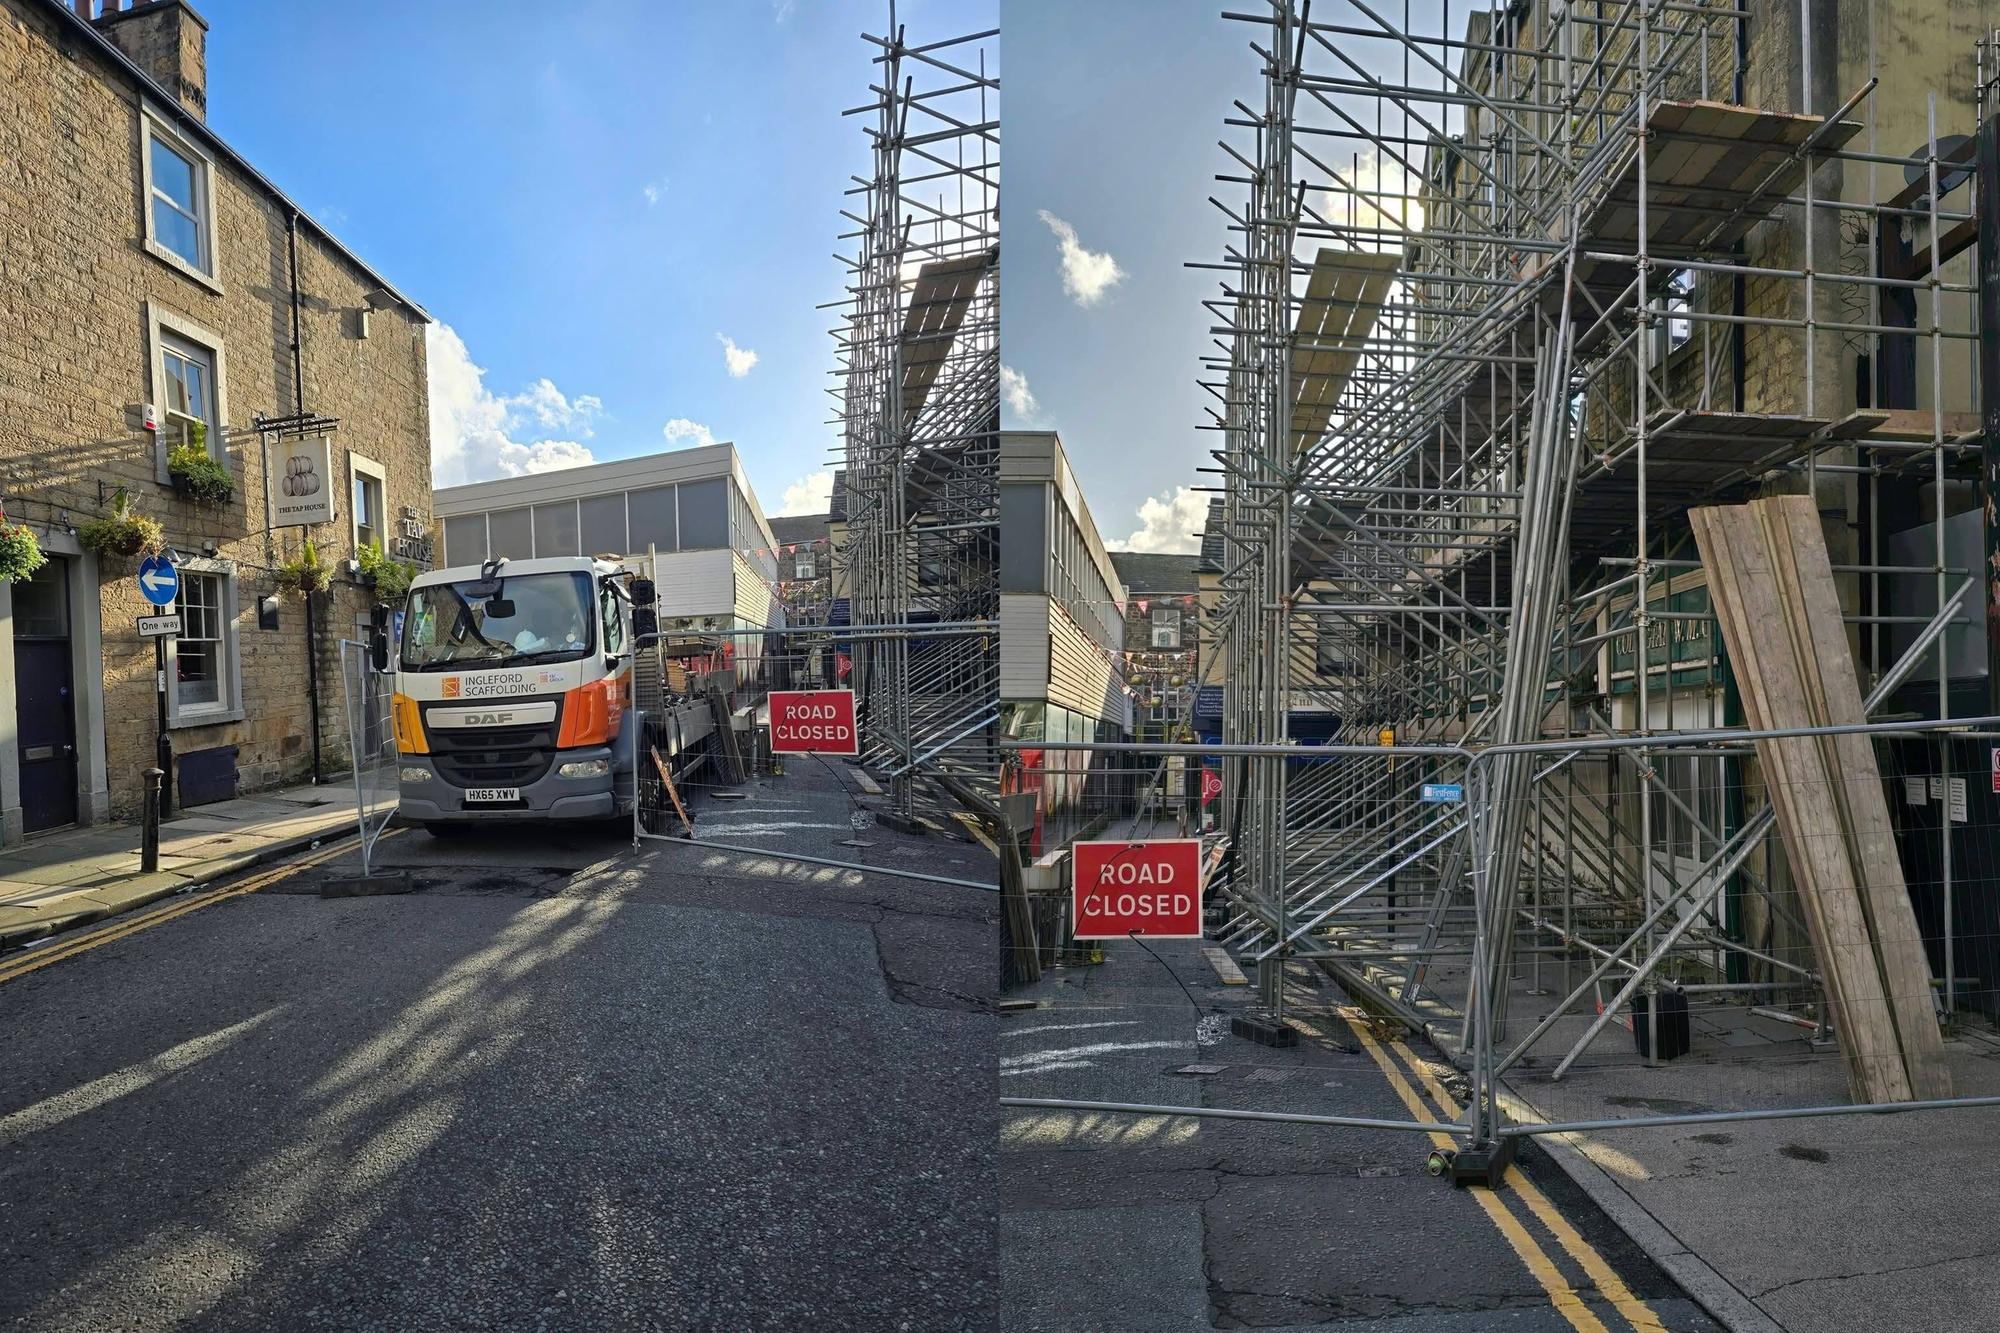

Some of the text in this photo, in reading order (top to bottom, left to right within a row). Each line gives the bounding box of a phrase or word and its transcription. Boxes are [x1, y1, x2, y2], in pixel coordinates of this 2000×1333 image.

[278, 506, 292, 514] THE
[304, 504, 326, 512] HOUSE
[405, 518, 424, 539] TAP
[398, 538, 432, 560] HOUSE
[141, 620, 179, 631] One way
[465, 673, 523, 686] INGLEFORD
[465, 683, 537, 697] SCAFFOLDING
[465, 713, 513, 725] DAF
[786, 705, 836, 719] ROAD
[777, 725, 849, 740] CLOSED
[469, 788, 515, 800] HX65 XWV
[1100, 863, 1175, 885] ROAD
[1083, 894, 1191, 917] CLOSED
